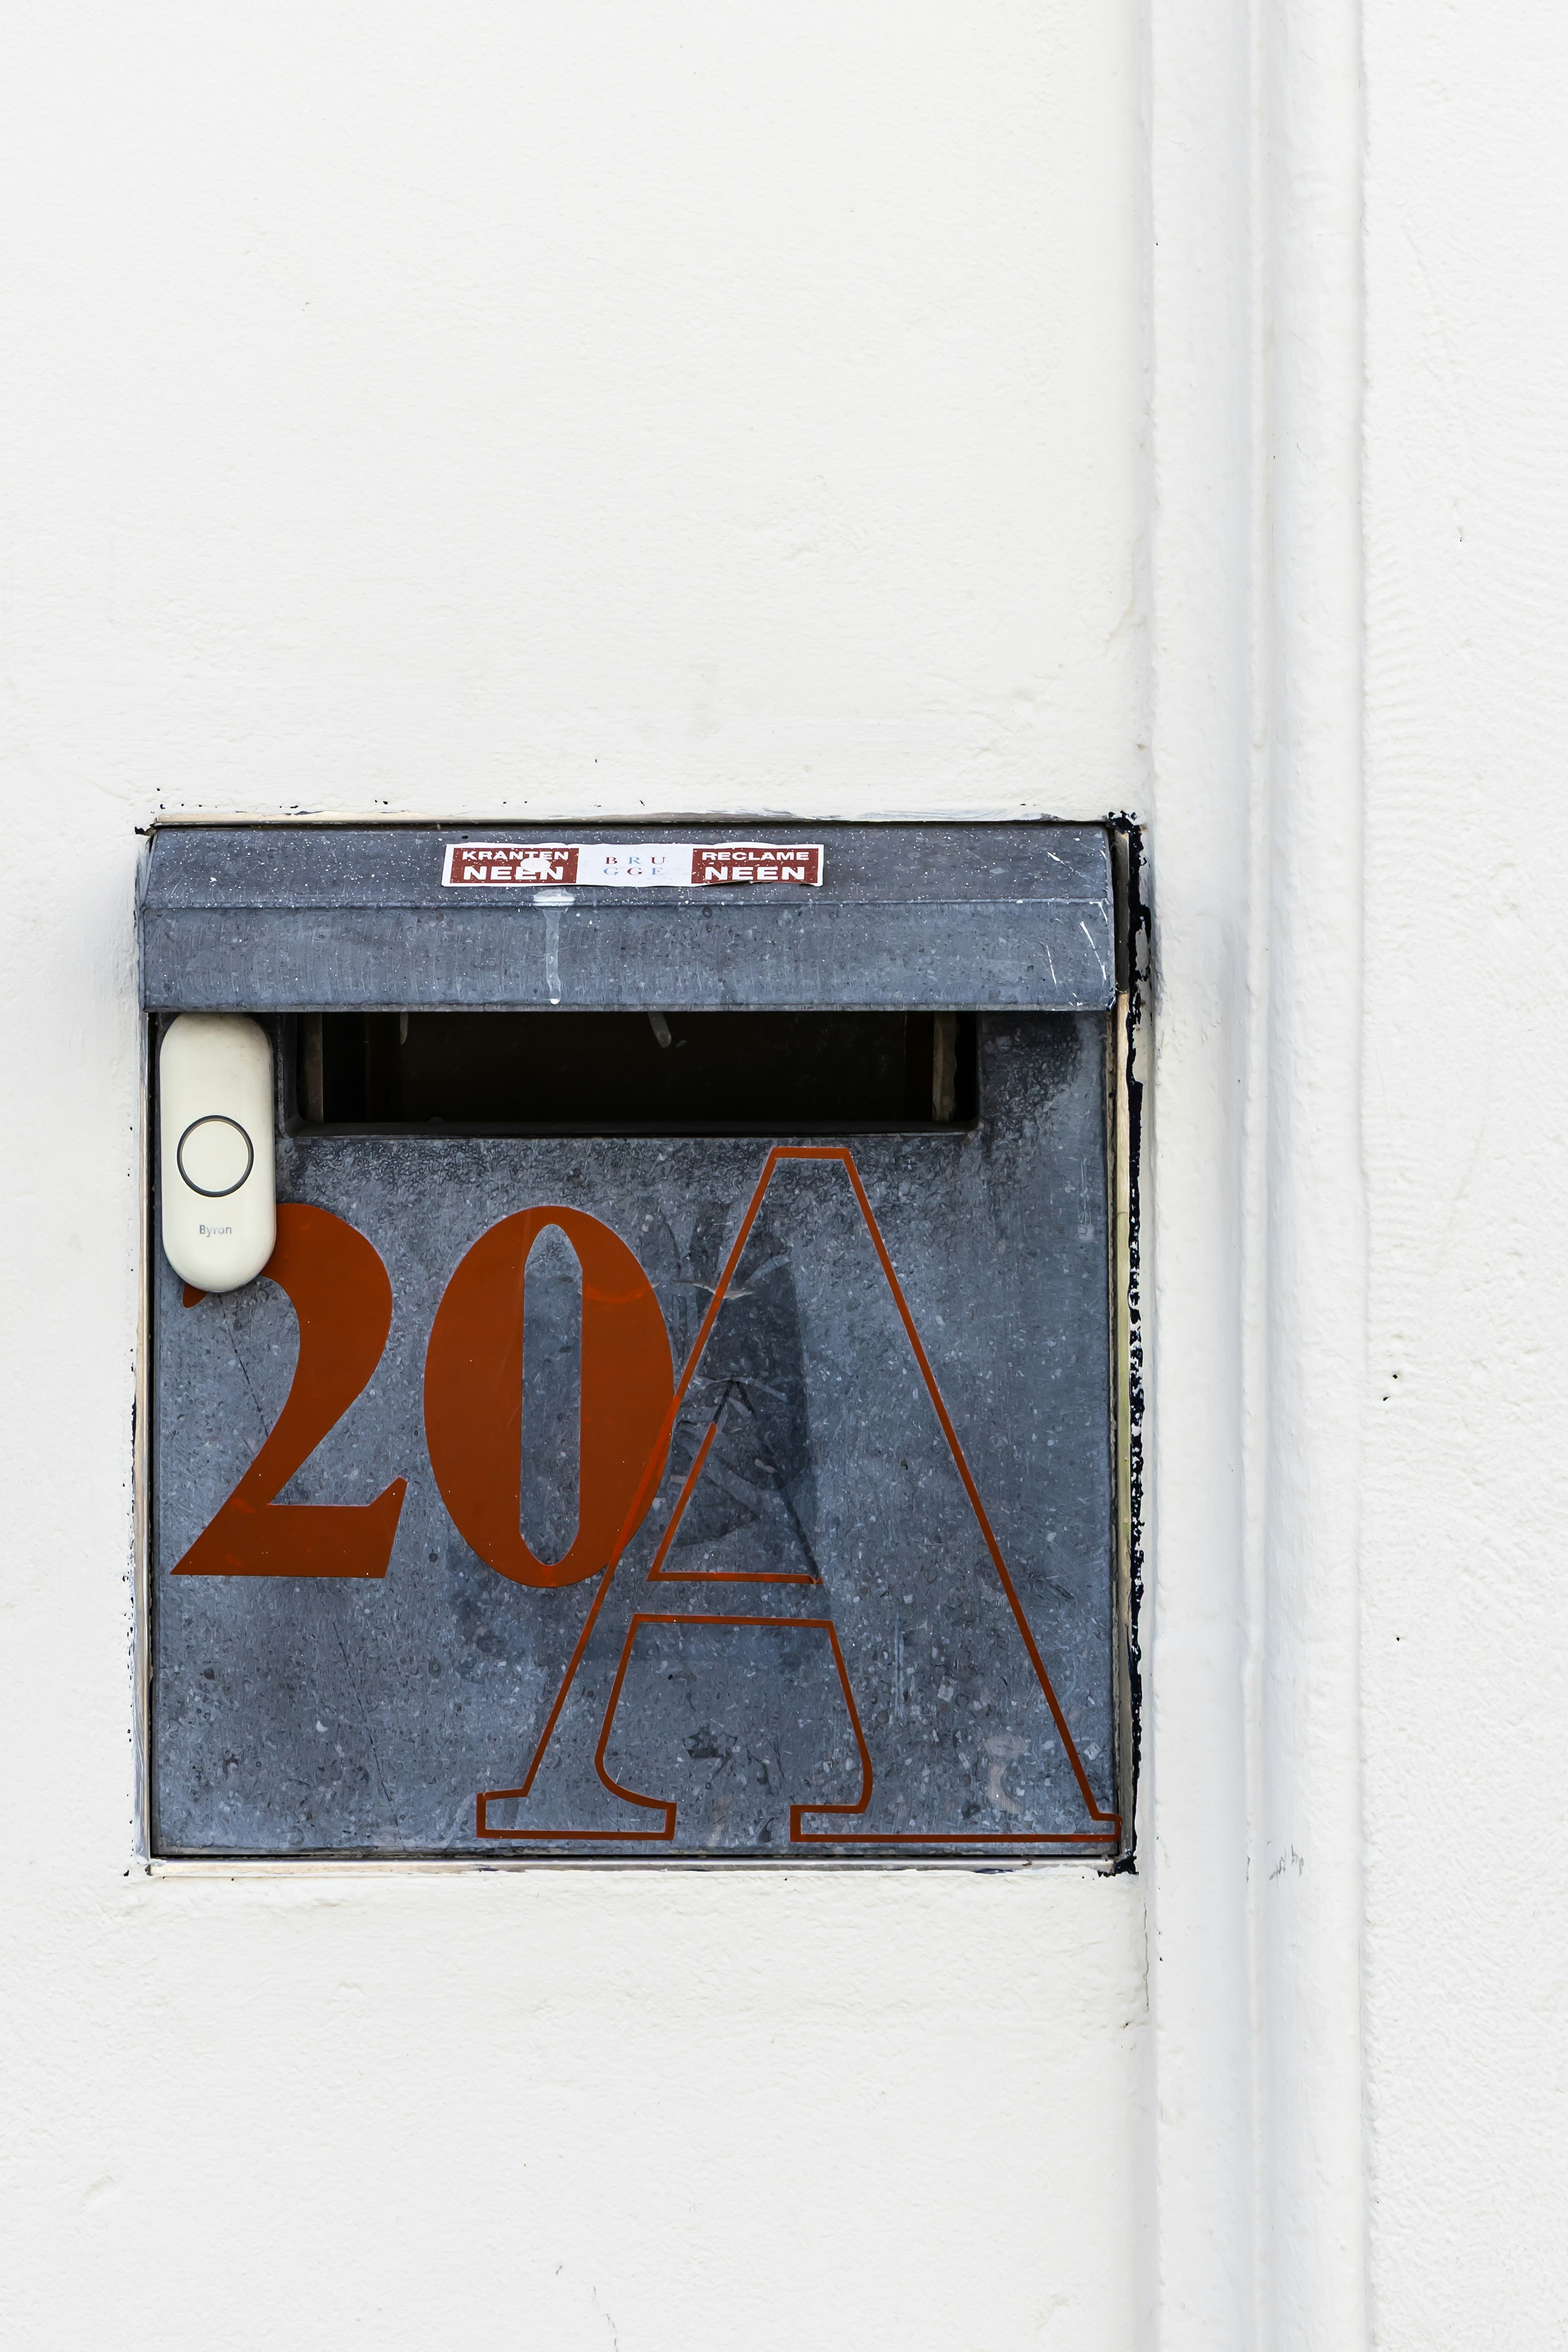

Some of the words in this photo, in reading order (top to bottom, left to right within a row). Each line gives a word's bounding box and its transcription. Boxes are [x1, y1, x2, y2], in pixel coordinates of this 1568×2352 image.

[462, 851, 569, 861] KRANTEN
[702, 851, 809, 861] RECLAME
[463, 866, 564, 881] NEEN
[704, 866, 805, 881] NEEN
[200, 1225, 232, 1237] Byron
